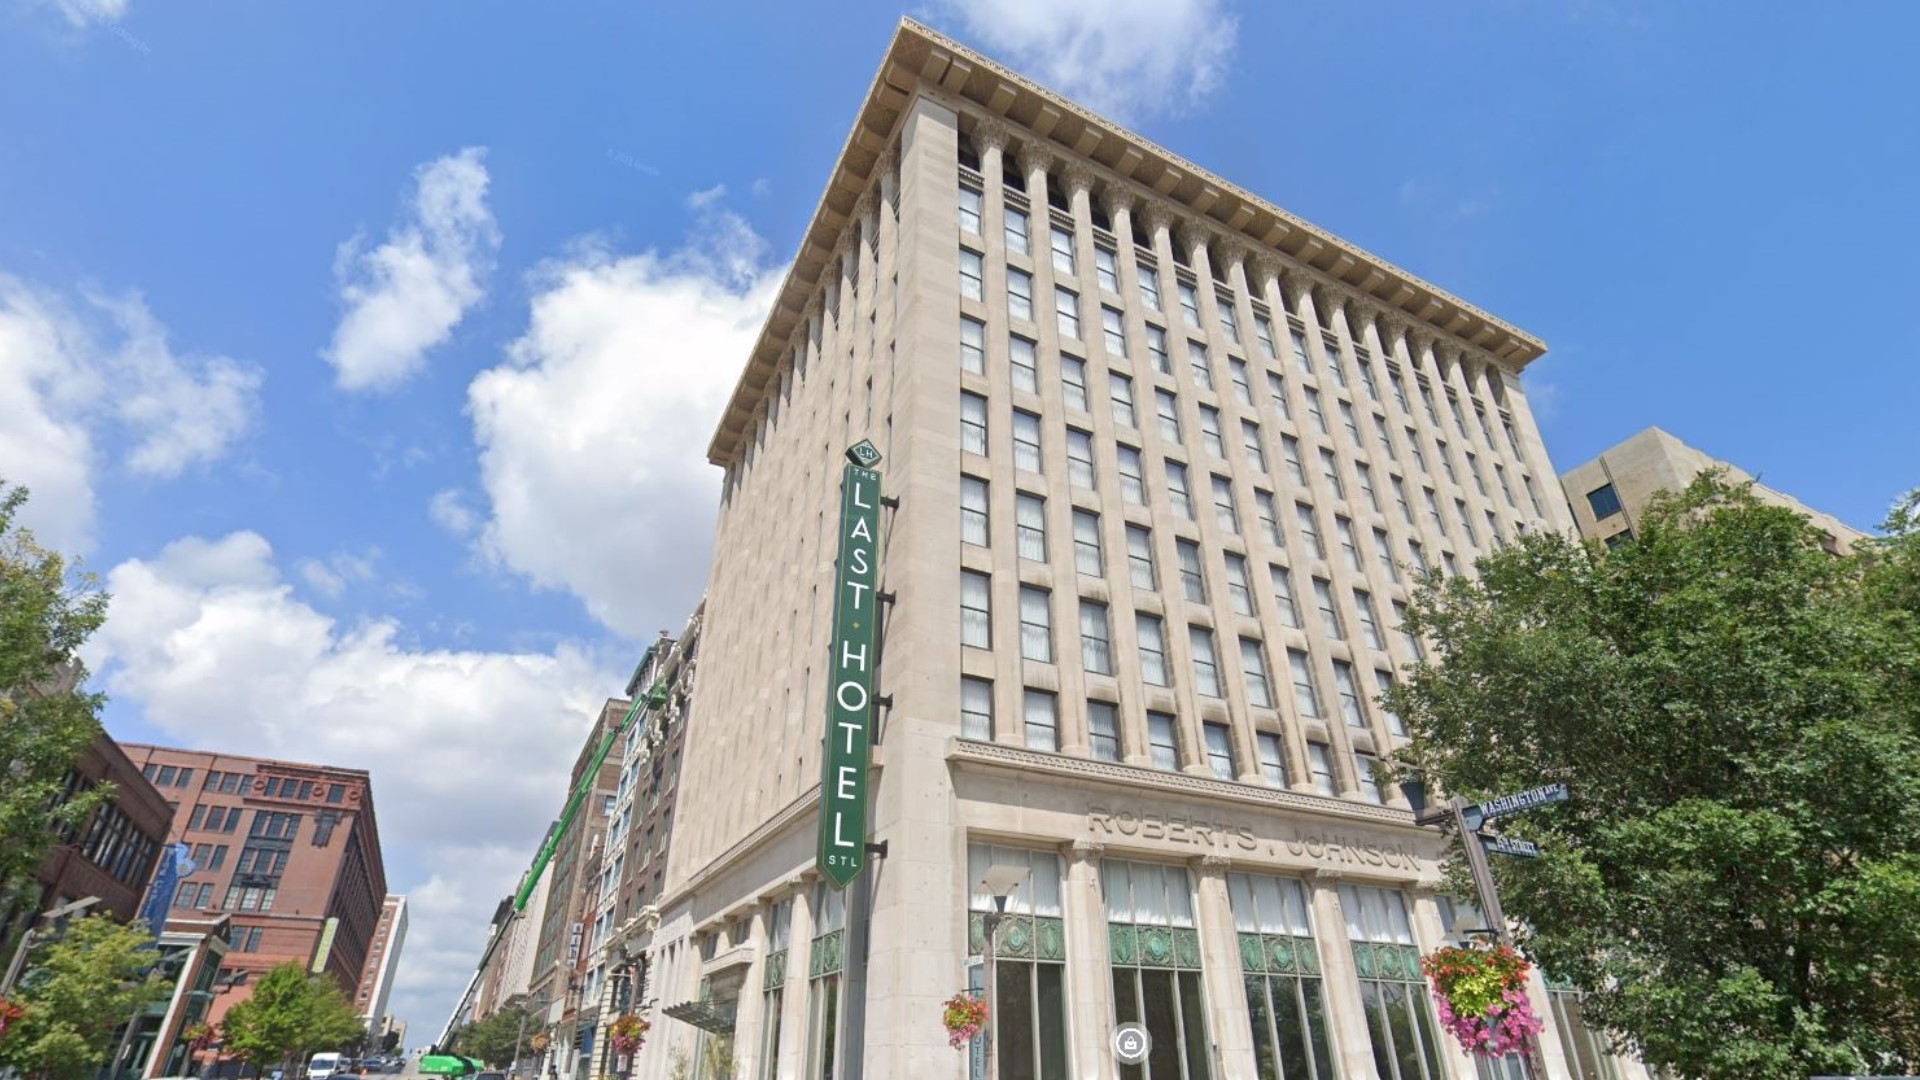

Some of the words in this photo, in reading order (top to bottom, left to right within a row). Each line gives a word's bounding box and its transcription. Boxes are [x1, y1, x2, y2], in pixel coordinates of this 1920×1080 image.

[859, 447, 873, 459] LH
[854, 468, 877, 481] THE
[846, 482, 872, 610] LAST
[834, 640, 868, 848] HOTEL
[1478, 786, 1547, 817] WASHINGTON
[1545, 783, 1559, 795] AVE
[828, 854, 858, 868] STL
[1286, 828, 1422, 872] JOHNSON
